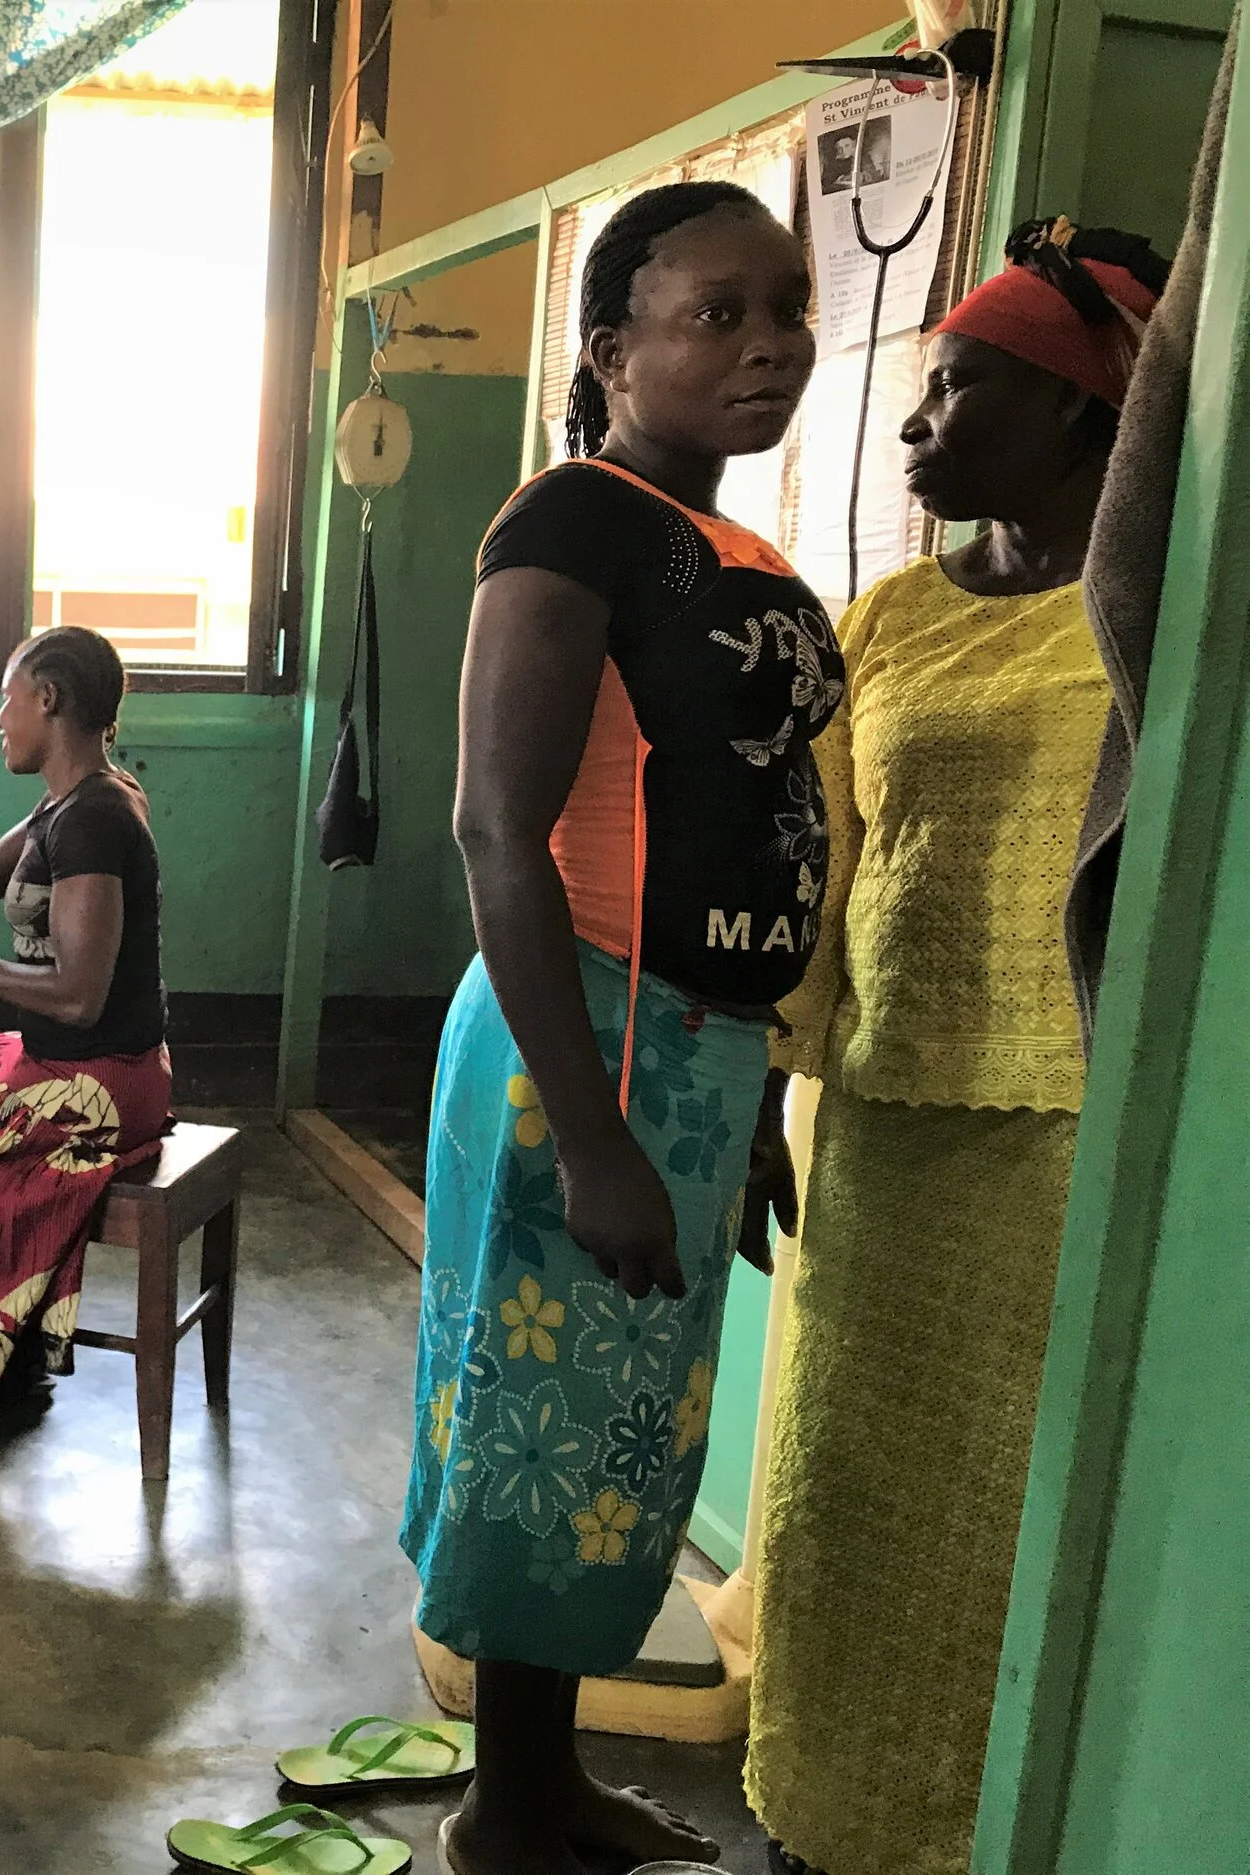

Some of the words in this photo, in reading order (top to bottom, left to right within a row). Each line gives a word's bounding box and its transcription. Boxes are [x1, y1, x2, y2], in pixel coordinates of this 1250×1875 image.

[821, 85, 891, 112] Programme
[824, 114, 837, 124] St
[893, 94, 905, 104] de
